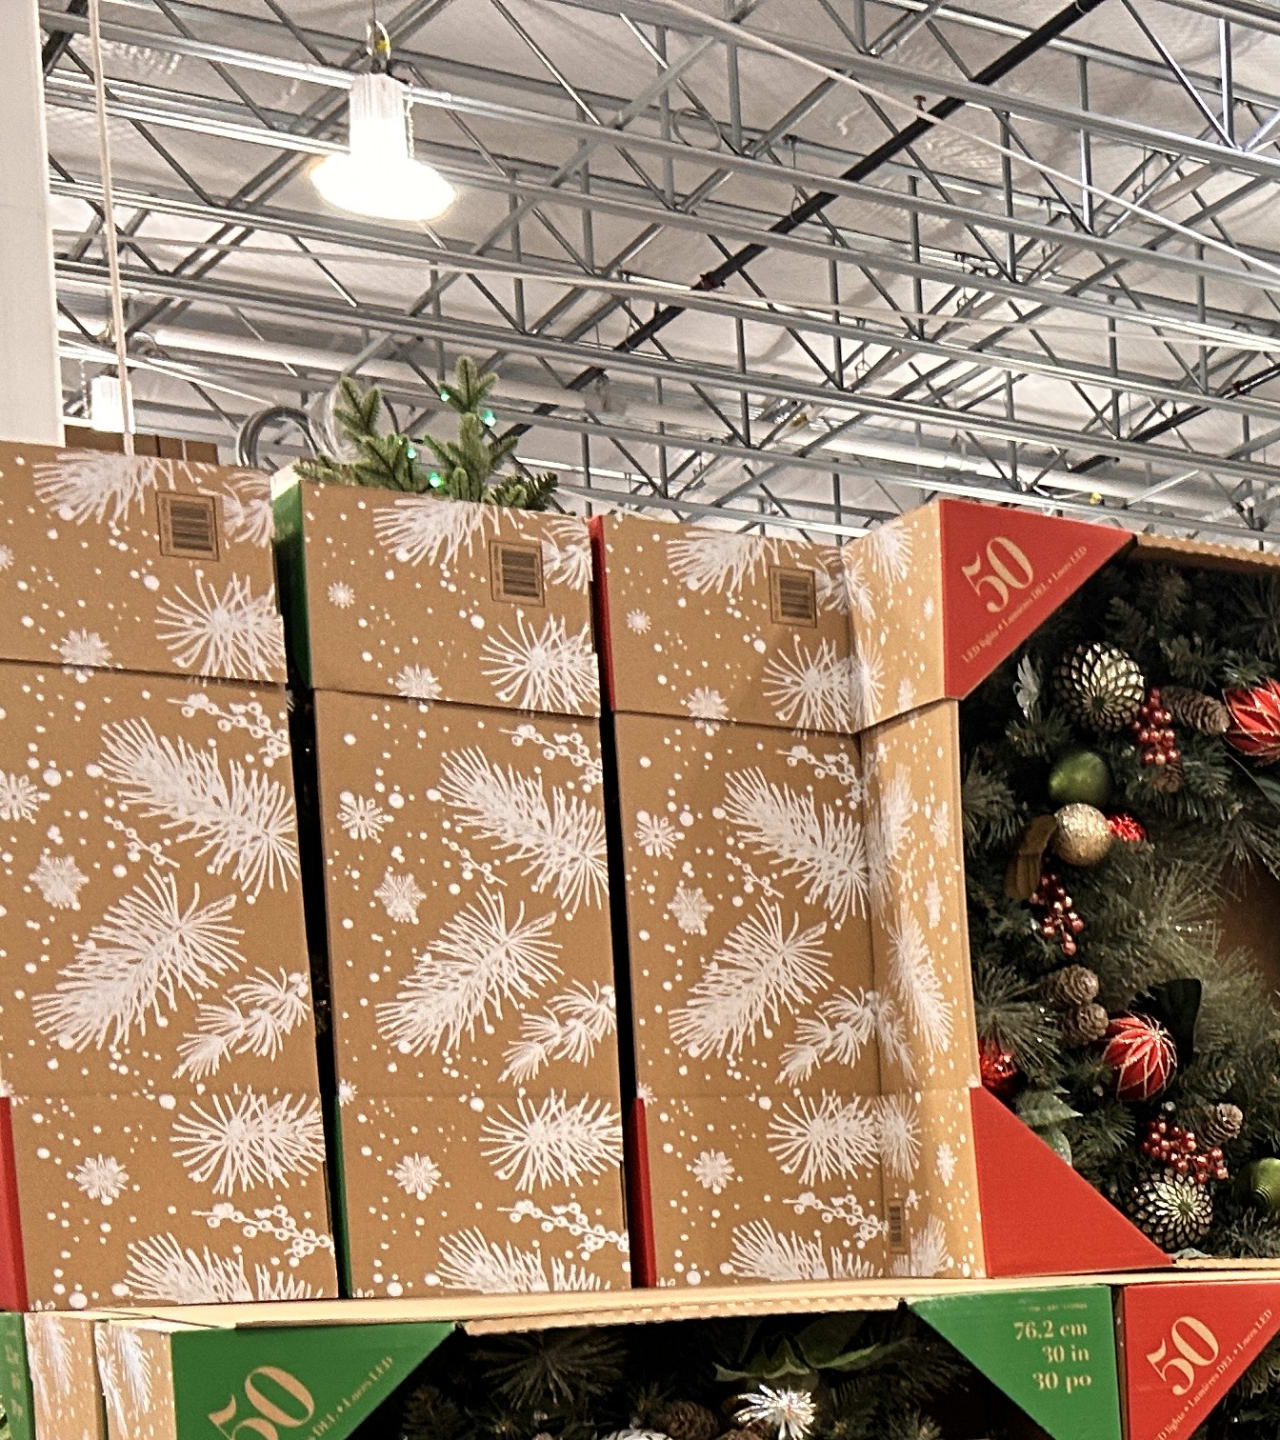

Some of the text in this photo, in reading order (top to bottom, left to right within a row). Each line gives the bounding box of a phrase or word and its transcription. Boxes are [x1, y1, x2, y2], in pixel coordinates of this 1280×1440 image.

[961, 536, 1034, 613] 50
[1014, 1321, 1088, 1341] 76.2 cm
[1041, 1346, 1090, 1364] 30 in
[1146, 1315, 1220, 1398] 50
[1166, 1412, 1186, 1435] lights
[1187, 1371, 1220, 1409] Lumières
[1216, 1354, 1236, 1376] DEL
[1237, 1329, 1259, 1351] Luces
[1255, 1309, 1274, 1331] LED
[1032, 1371, 1092, 1395] 30 po
